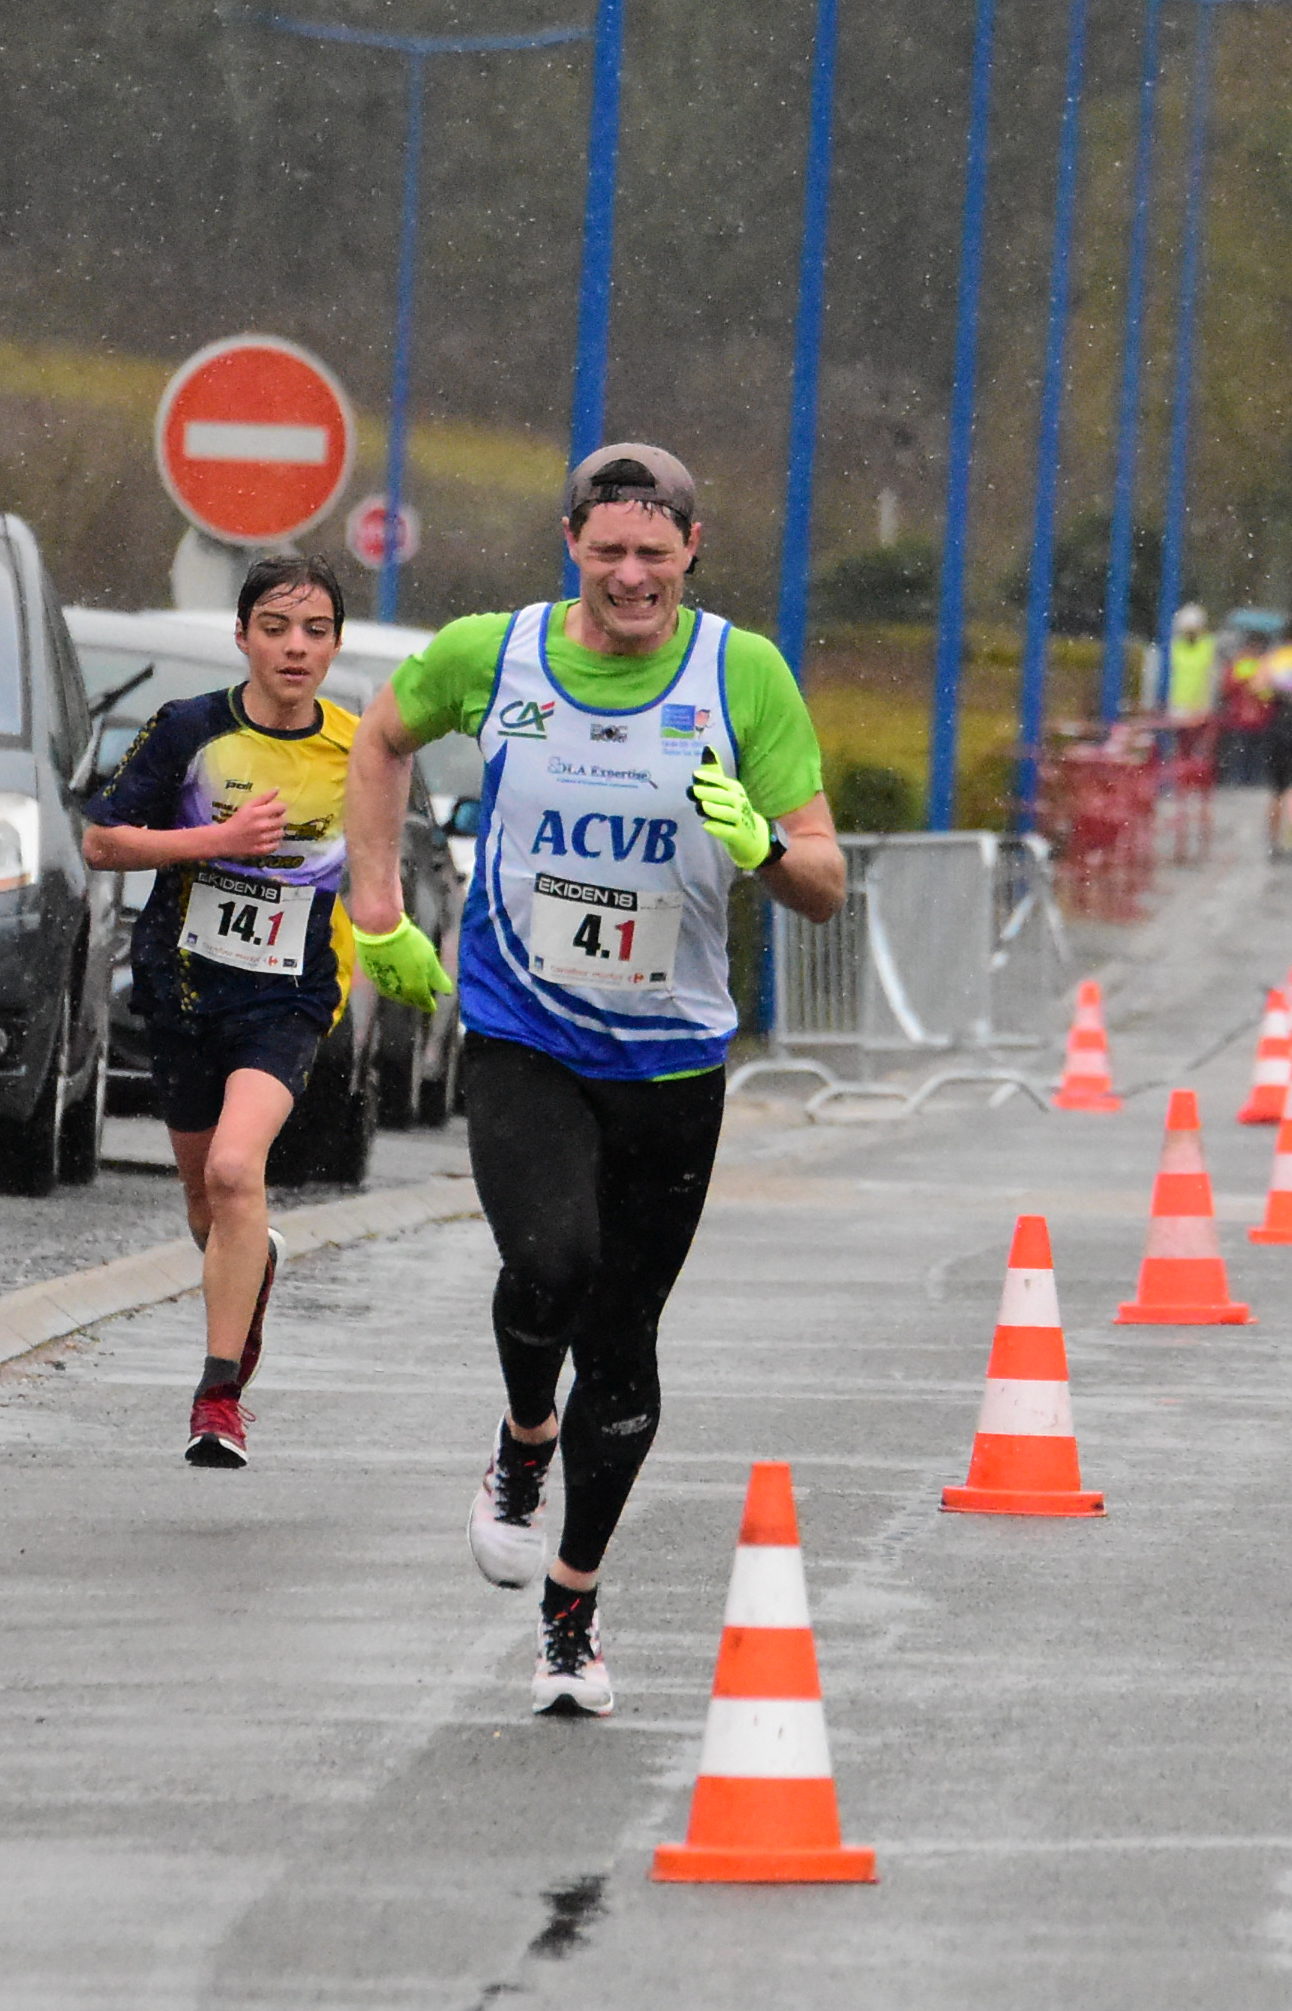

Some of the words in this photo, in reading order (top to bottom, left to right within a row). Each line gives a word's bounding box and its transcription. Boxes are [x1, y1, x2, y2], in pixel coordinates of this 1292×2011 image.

[531, 809, 678, 865] ACVB
[198, 872, 258, 896] EKIDEN
[260, 886, 278, 901] 18
[538, 876, 609, 904] EKIDEN
[613, 893, 634, 909] 18
[218, 900, 284, 946] 14.1
[572, 913, 635, 962] 4.1
